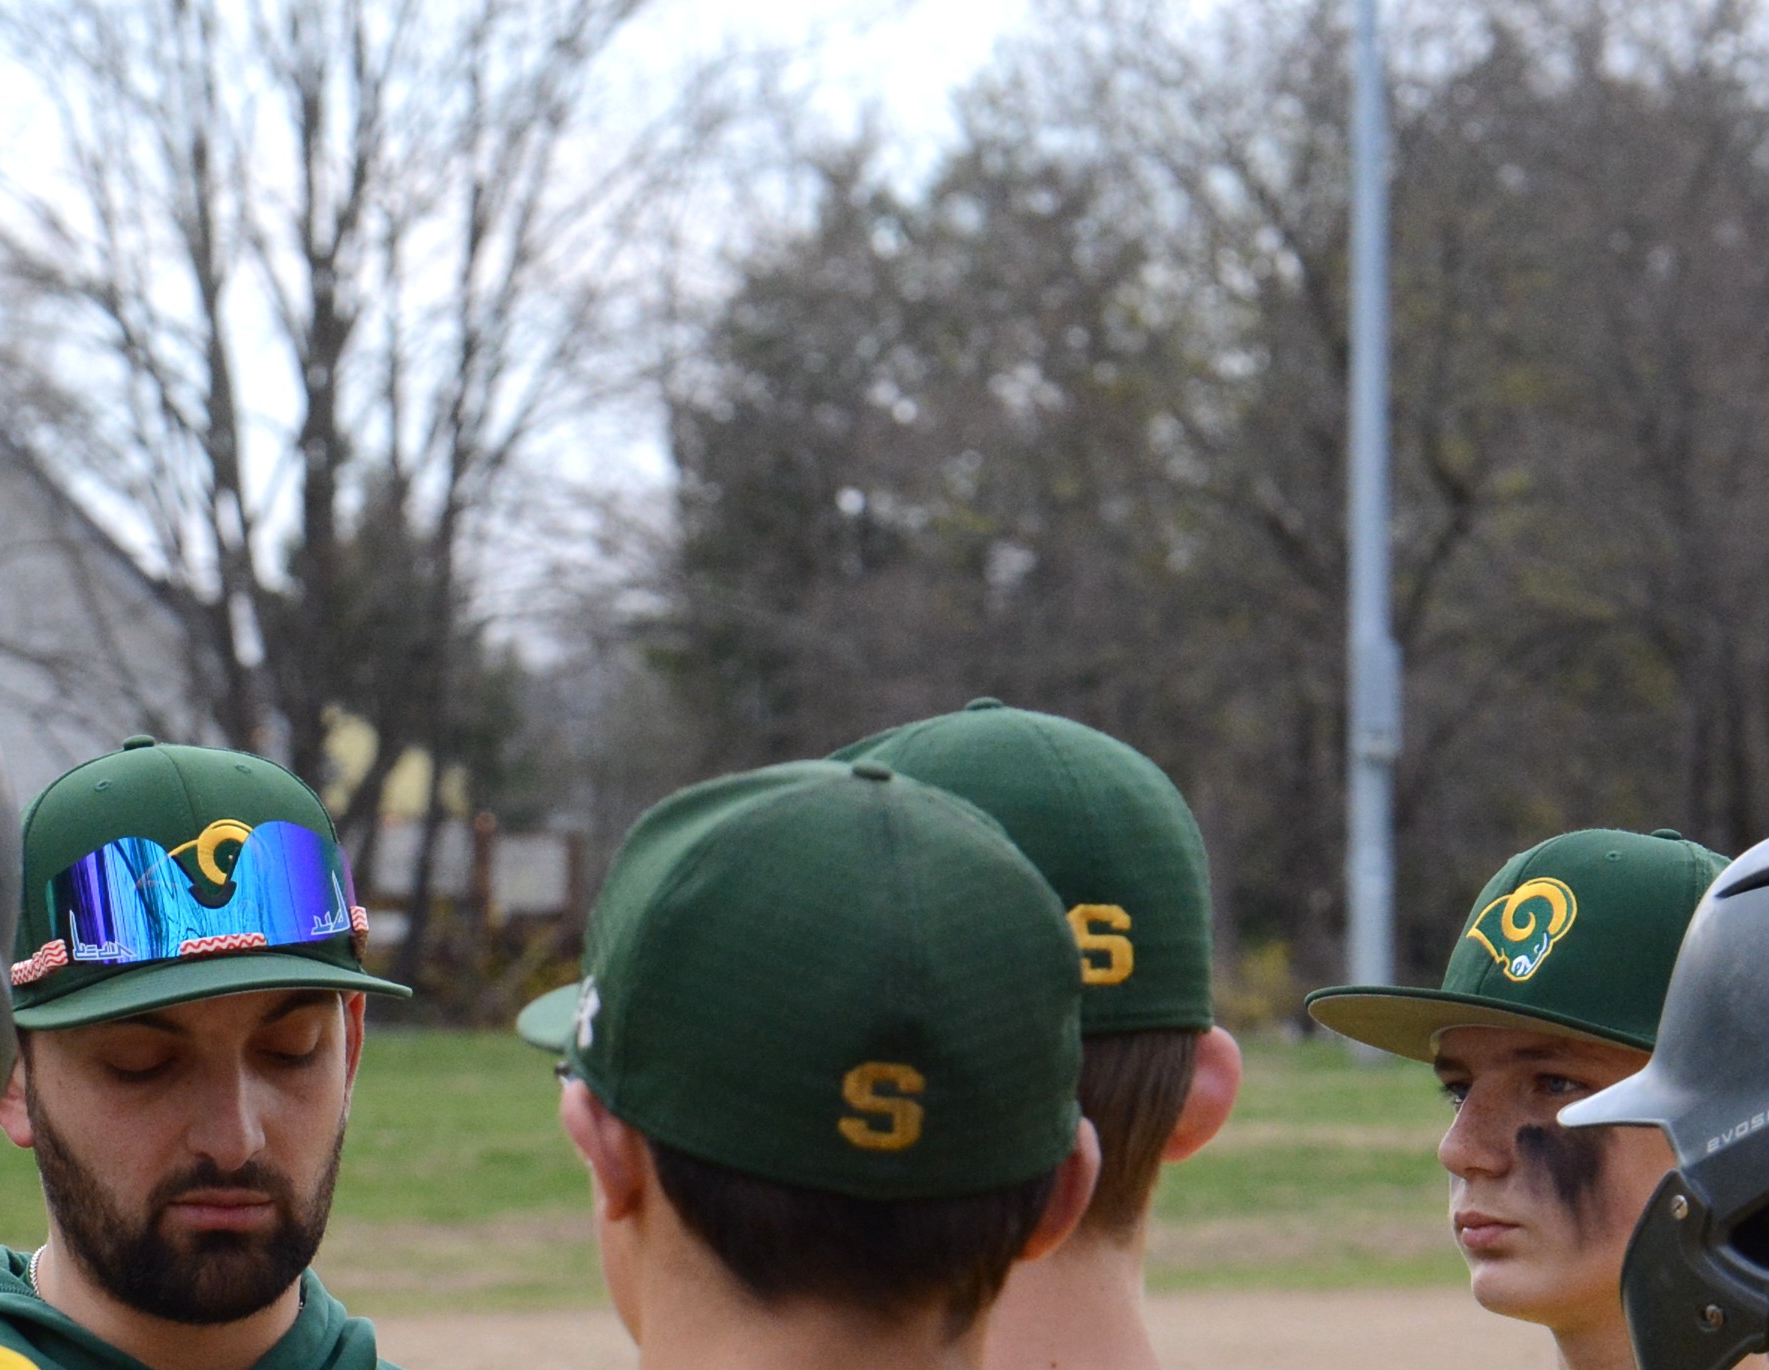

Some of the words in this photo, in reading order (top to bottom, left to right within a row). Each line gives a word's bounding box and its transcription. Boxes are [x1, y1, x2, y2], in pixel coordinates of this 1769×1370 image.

[1064, 903, 1134, 986] S
[837, 1061, 927, 1151] S
[1706, 1110, 1769, 1154] EVOS
